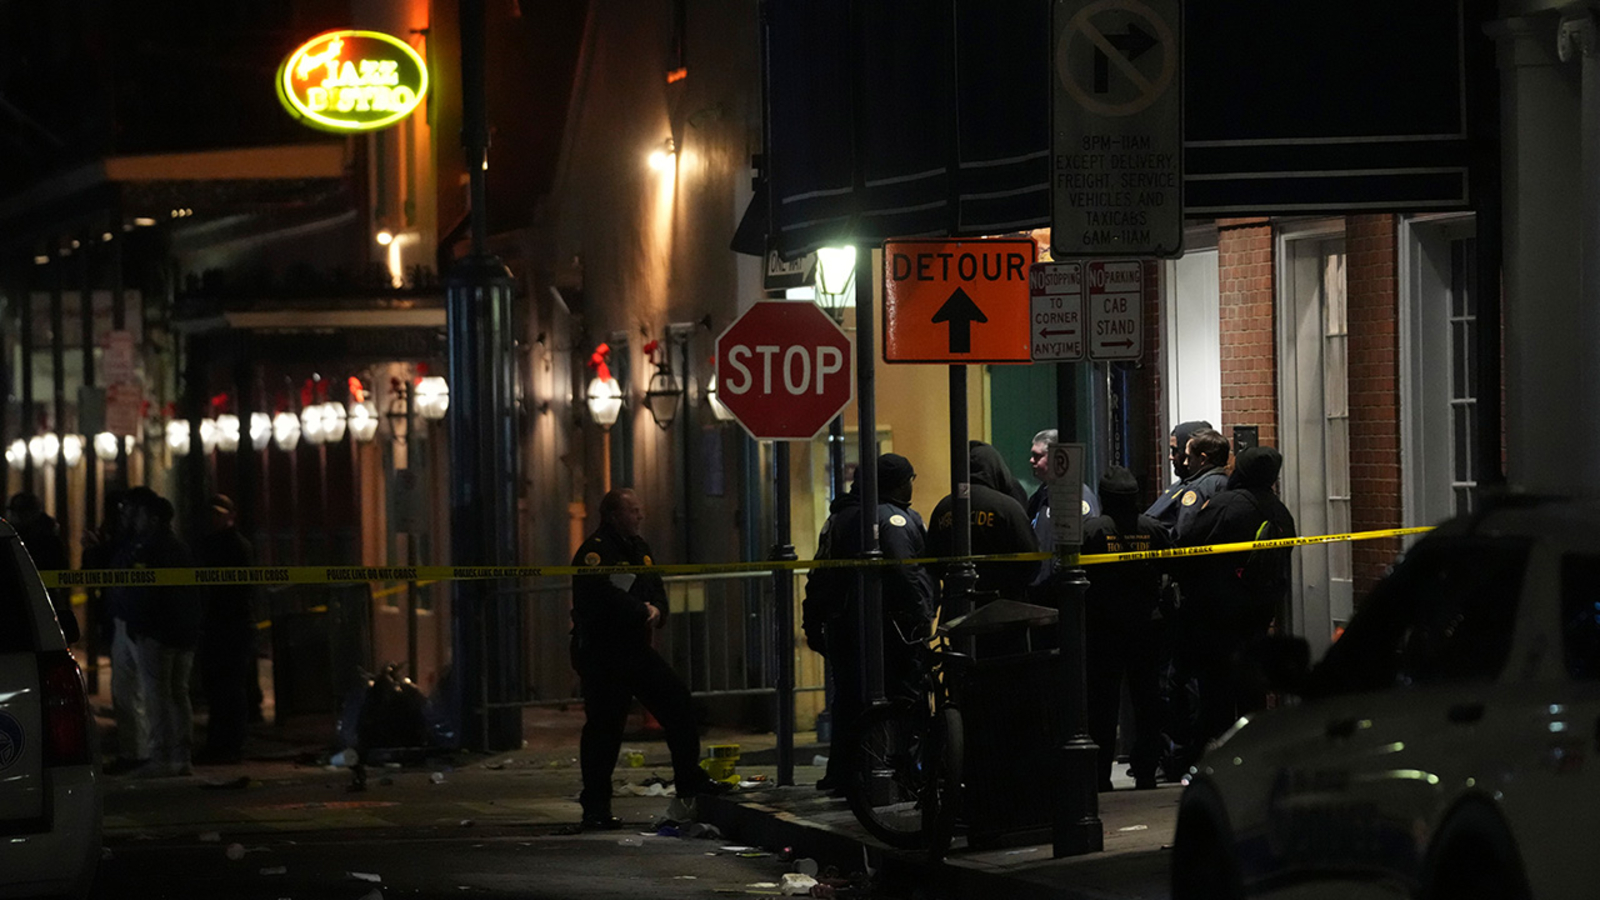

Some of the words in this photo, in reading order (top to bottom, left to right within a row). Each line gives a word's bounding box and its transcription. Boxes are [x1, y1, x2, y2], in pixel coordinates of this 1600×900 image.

[321, 59, 399, 88] JAZZ
[306, 85, 416, 112] BISTRO
[1056, 155, 1105, 169] EXCEPT
[1121, 172, 1175, 188] SERVICE
[1069, 192, 1131, 207] VEHICLES
[1140, 192, 1164, 206] AND
[1086, 211, 1147, 226] TAXICABS
[892, 253, 1025, 281] DETOUR
[1031, 271, 1045, 290] NO
[1045, 272, 1080, 286] STOPPING
[1090, 269, 1105, 288] NO
[1105, 270, 1140, 283] PARKING
[1050, 298, 1063, 309] TO
[1103, 298, 1128, 314] CAB
[1035, 312, 1078, 324] CORNER
[1096, 319, 1135, 335] STAND
[1034, 342, 1080, 354] ANYTIME
[726, 344, 843, 395] STOP
[58, 572, 84, 584] POLICE
[85, 572, 101, 584] LINE
[102, 571, 113, 584] DO
[115, 571, 129, 584] NOT
[130, 570, 156, 583] CROSS
[195, 570, 220, 582] POLICE
[221, 570, 237, 582] LINE
[237, 570, 248, 582] DO
[249, 570, 264, 581] NOT
[265, 569, 289, 581] CROSS
[326, 569, 351, 580] POLICE
[352, 569, 367, 580] LINE
[367, 569, 378, 580] DO
[379, 569, 392, 579] NOT
